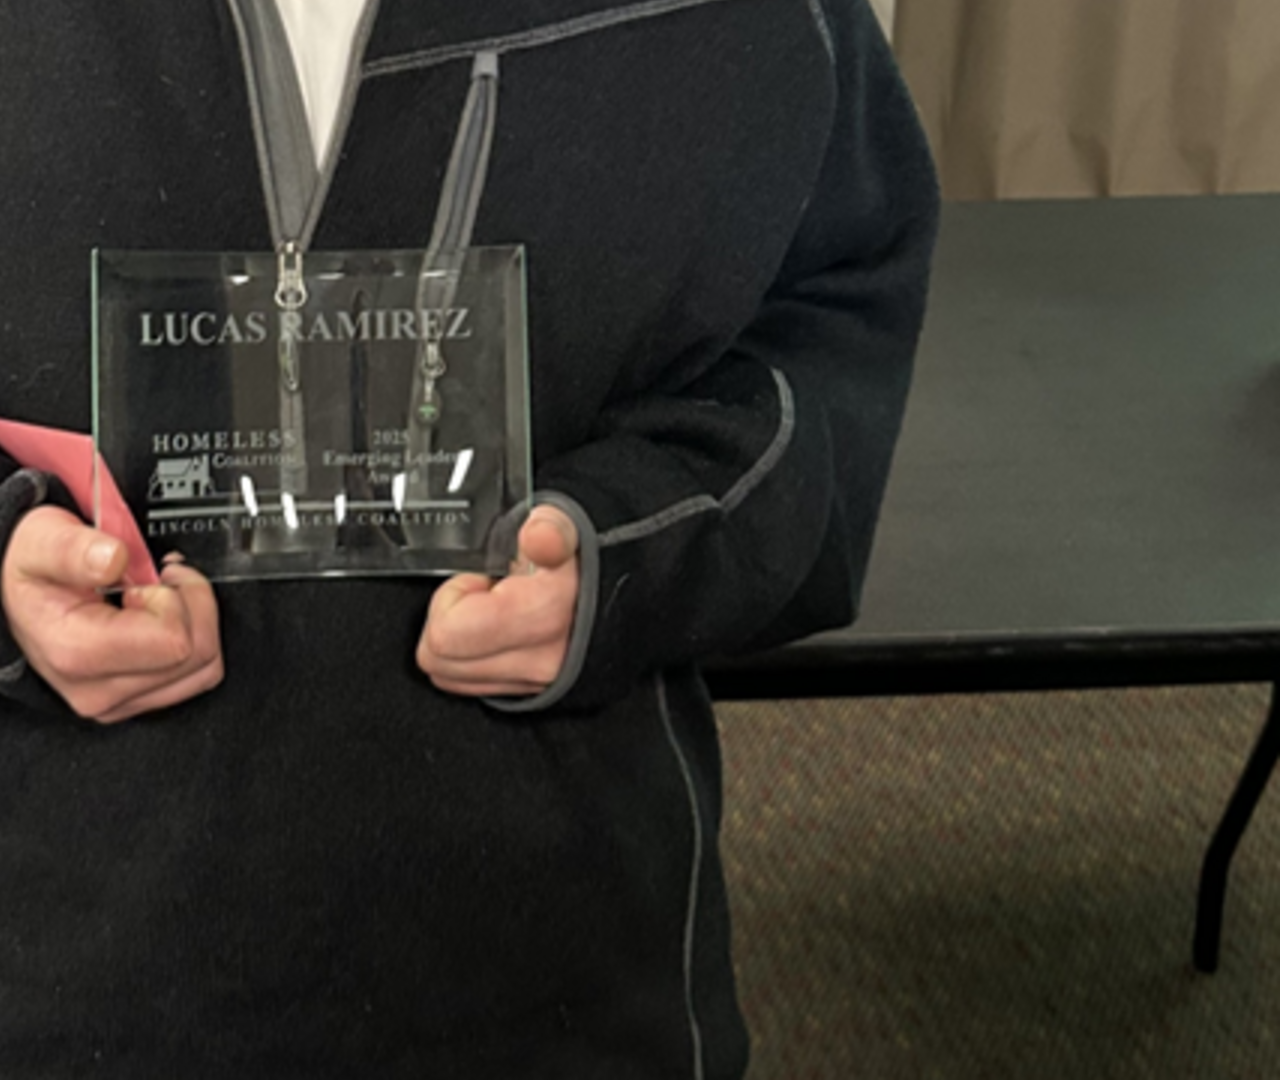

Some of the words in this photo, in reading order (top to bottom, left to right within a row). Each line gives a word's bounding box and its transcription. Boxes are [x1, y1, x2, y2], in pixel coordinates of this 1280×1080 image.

[139, 310, 268, 346] LUCAS
[280, 307, 472, 345] RAMIREZ
[152, 430, 298, 453] HOMELESS
[373, 429, 410, 445] 2025
[322, 448, 402, 468] Emerging
[357, 511, 471, 526] COALITION
